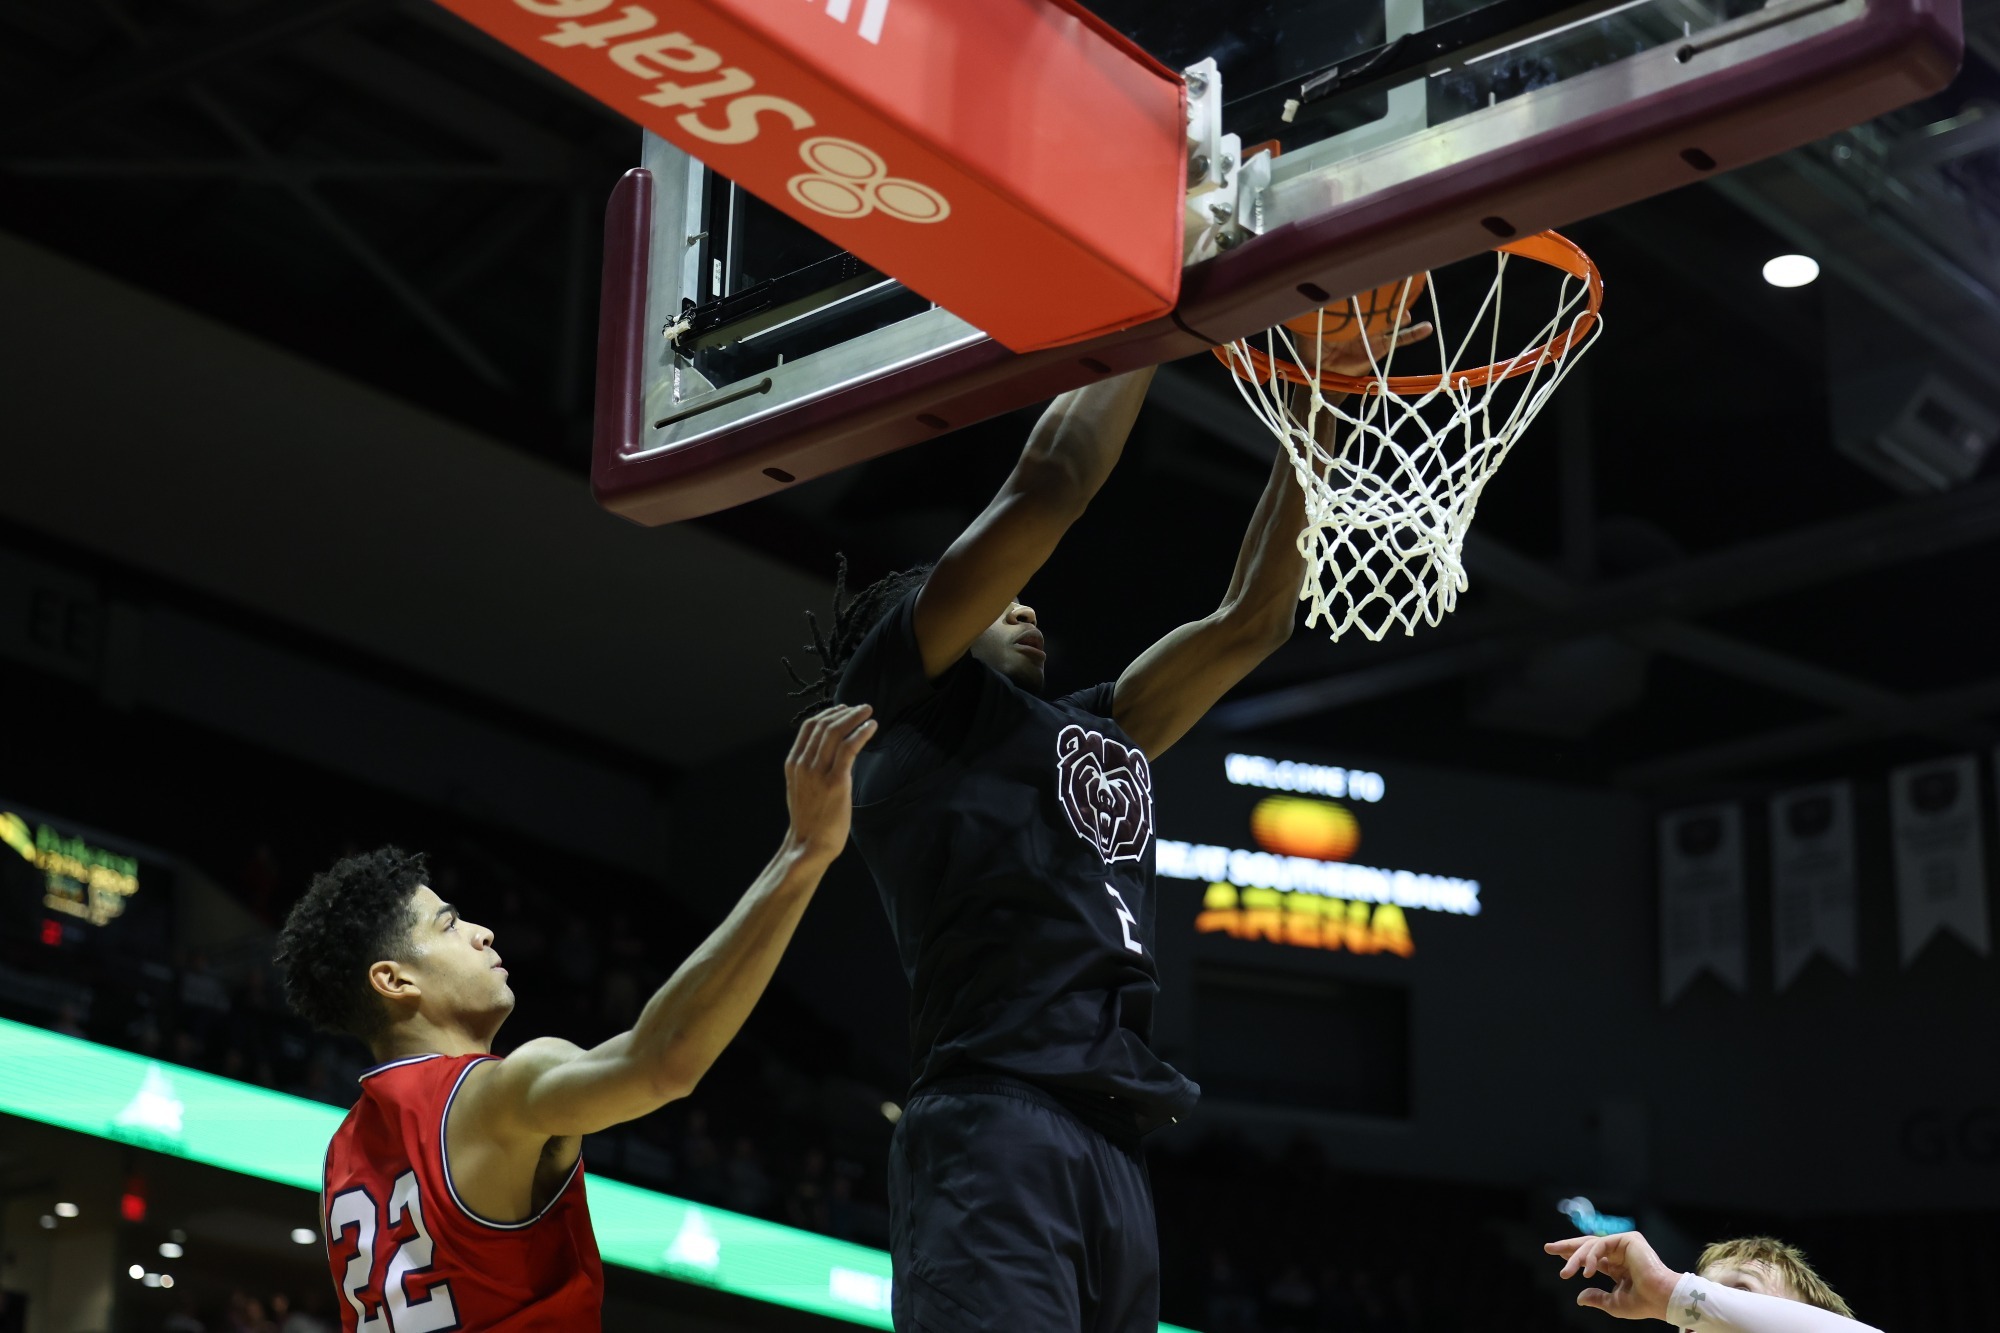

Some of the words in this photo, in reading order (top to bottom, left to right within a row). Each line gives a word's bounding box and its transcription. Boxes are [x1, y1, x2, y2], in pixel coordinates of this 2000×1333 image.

[1225, 753, 1346, 798] WELCOME
[1348, 769, 1385, 803] TO
[1105, 882, 1142, 954] 2
[1195, 881, 1415, 958] ARENA
[1390, 869, 1481, 915] BANK
[329, 1168, 460, 1333] 22
